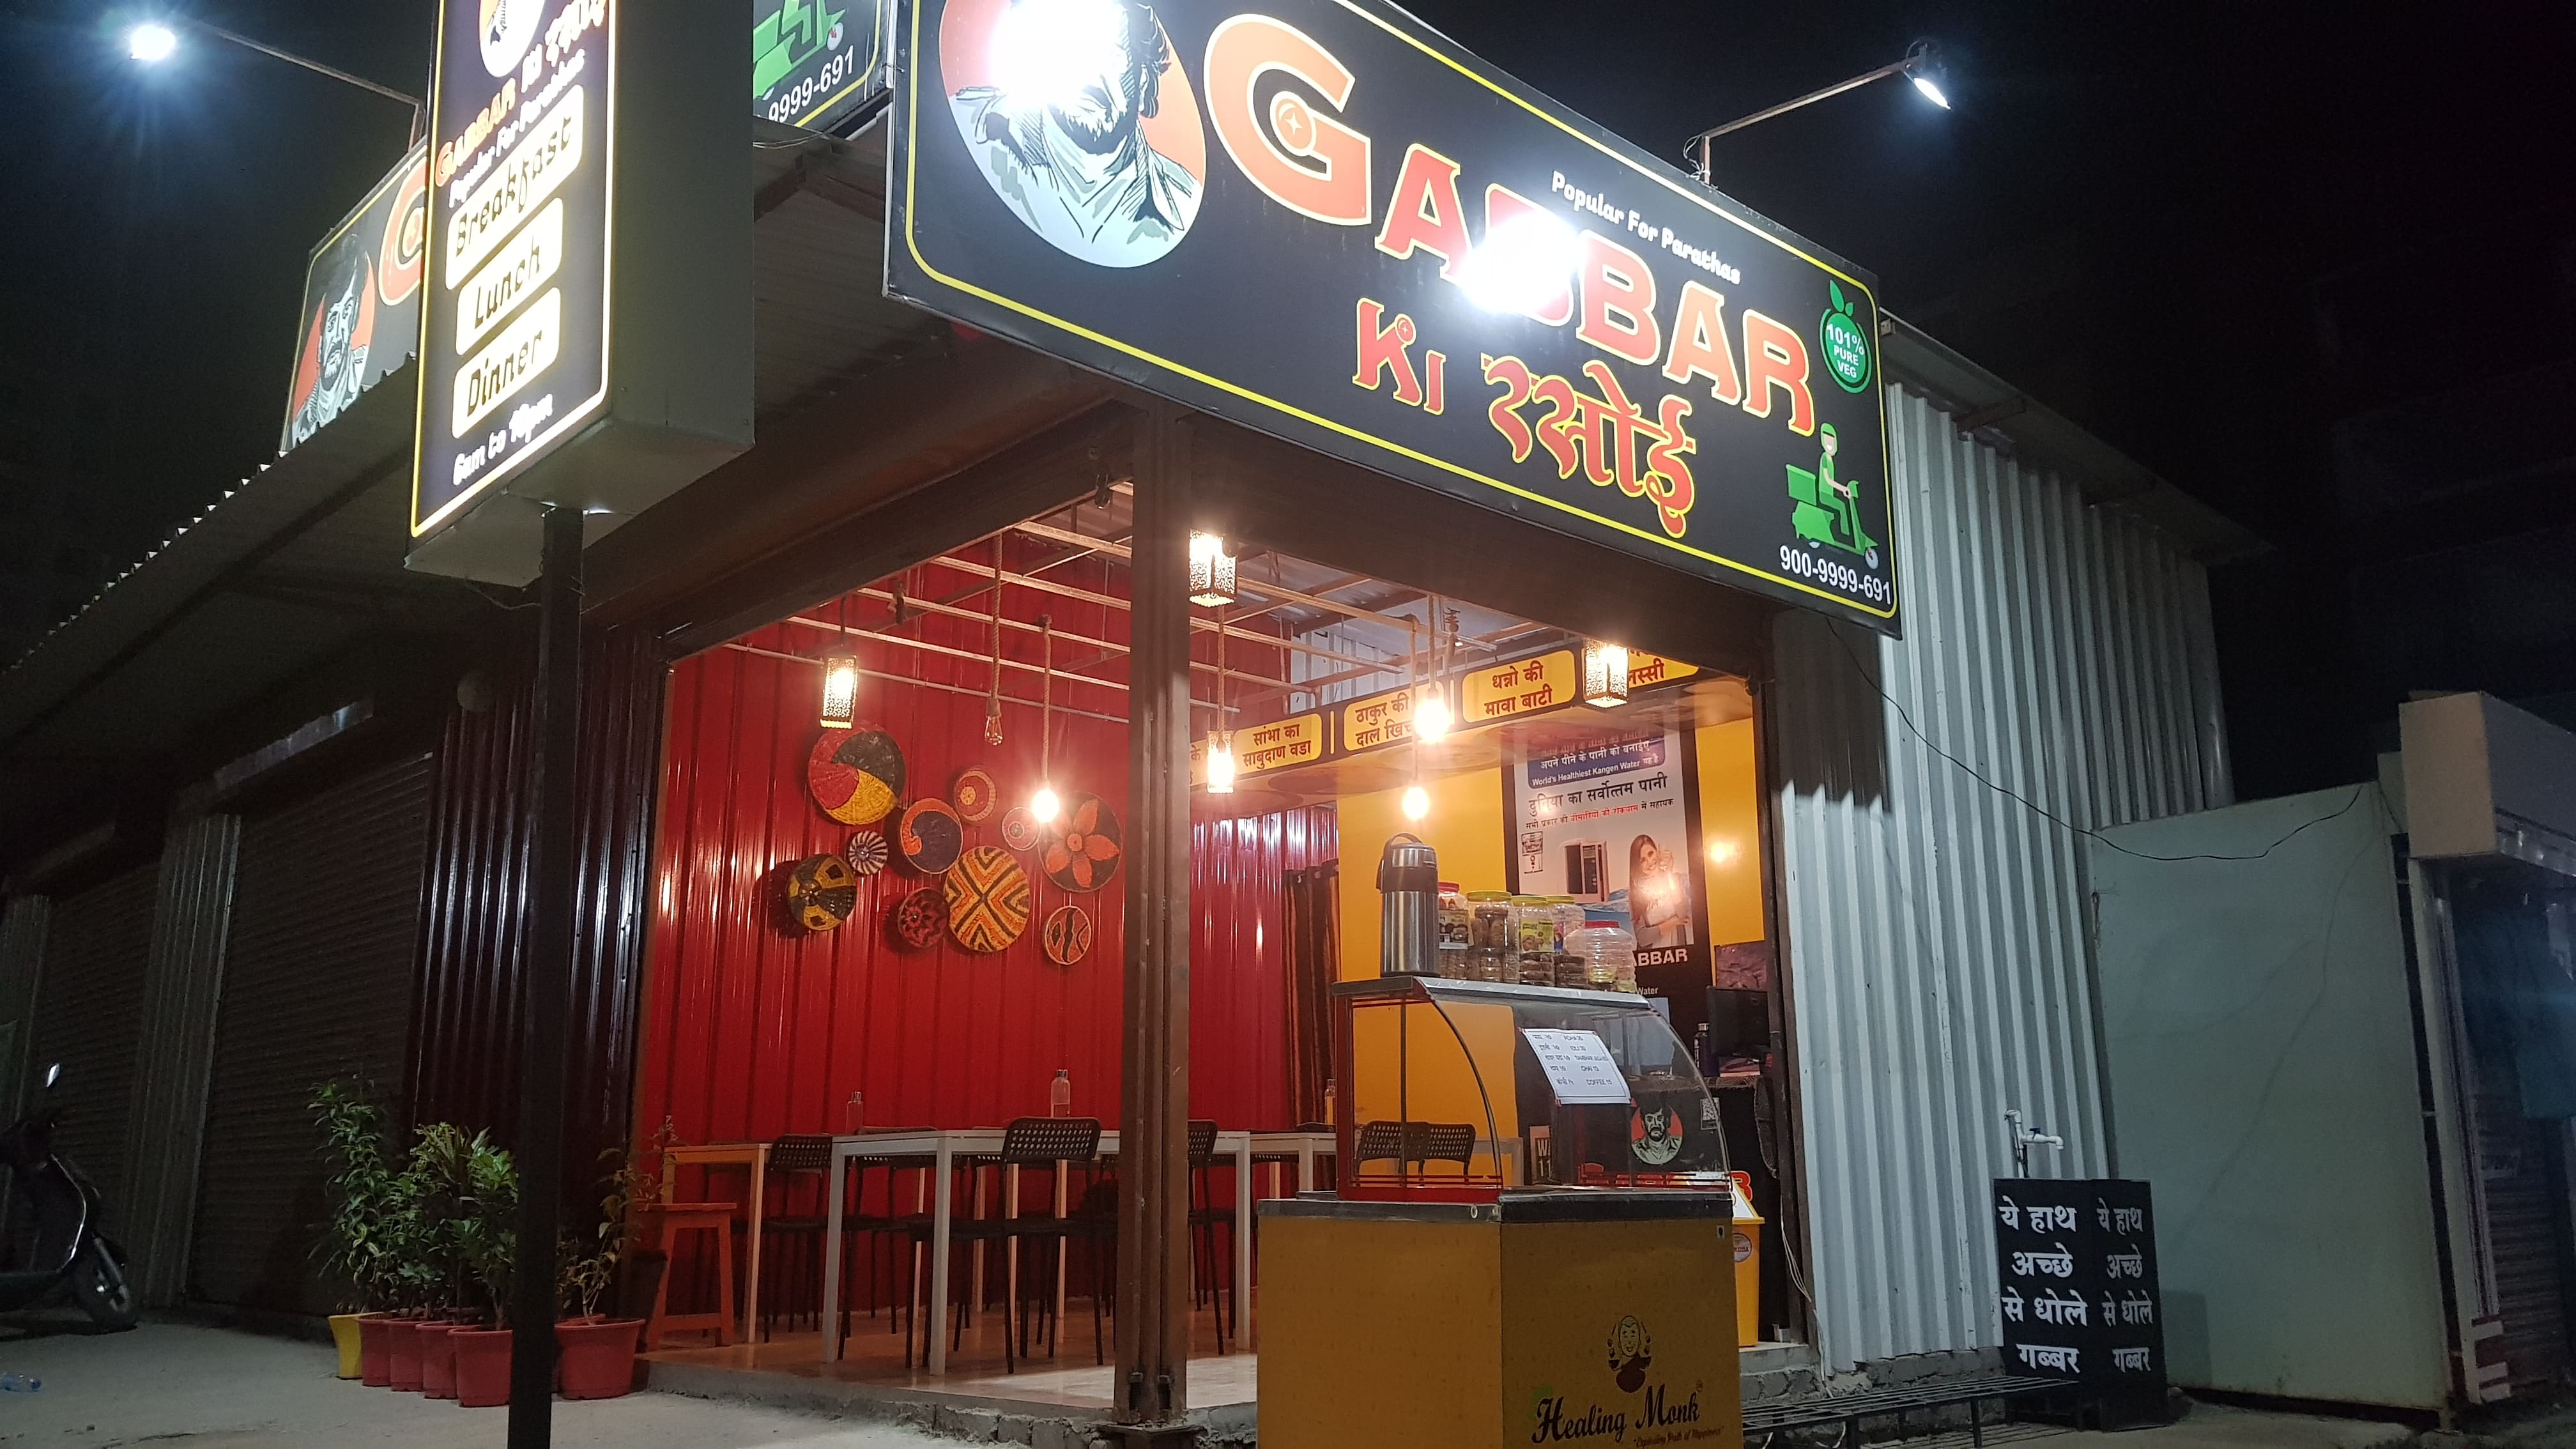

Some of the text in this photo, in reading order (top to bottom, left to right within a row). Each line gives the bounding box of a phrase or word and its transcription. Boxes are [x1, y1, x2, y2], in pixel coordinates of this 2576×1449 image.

[456, 116, 571, 257] Breakfast
[1552, 170, 1741, 285] Popular For Parathas
[475, 235, 540, 329] Lunch
[1827, 323, 1864, 356] 101%
[1833, 344, 1859, 366] PURE
[467, 330, 542, 417] Dinner
[1837, 360, 1857, 379] VEG
[488, 429, 506, 459] to
[1480, 353, 1696, 538] रसोई
[1779, 545, 1892, 605] 900-9999-691
[1492, 660, 1544, 689] धन्नो की
[1354, 692, 1409, 726] ठाकुर की
[1485, 684, 1553, 716] मावा बाटी
[1253, 723, 1300, 746] सांभा का
[1355, 719, 1412, 746] दाल खिच
[1532, 776, 1557, 786] World's
[1558, 769, 1591, 783] Healthiest
[1592, 764, 1619, 776] Kangen
[1620, 760, 1640, 770] Water
[1540, 756, 1560, 770] अपने
[1561, 753, 1577, 766] पीने
[1579, 751, 1587, 762] के
[1588, 747, 1607, 760] पानी
[1610, 746, 1620, 755] को
[1567, 791, 1583, 804] का
[1586, 780, 1634, 802] सर्वोत्तम
[1638, 771, 1667, 792] पानी
[1633, 948, 1687, 967] BBAR
[1636, 987, 1659, 995] Water
[1998, 1195, 2077, 1234] ये हाथ
[2096, 1197, 2143, 1236] ये हाथ
[2011, 1242, 2073, 1278] अच्छे
[2106, 1243, 2143, 1278] अच्छे
[2001, 1286, 2089, 1326] से धोले
[2101, 1289, 2154, 1327] से धोले
[2016, 1344, 2080, 1374] गब्बर
[2112, 1347, 2151, 1373] गब्बर
[1531, 1384, 1699, 1443] Healing Monk
